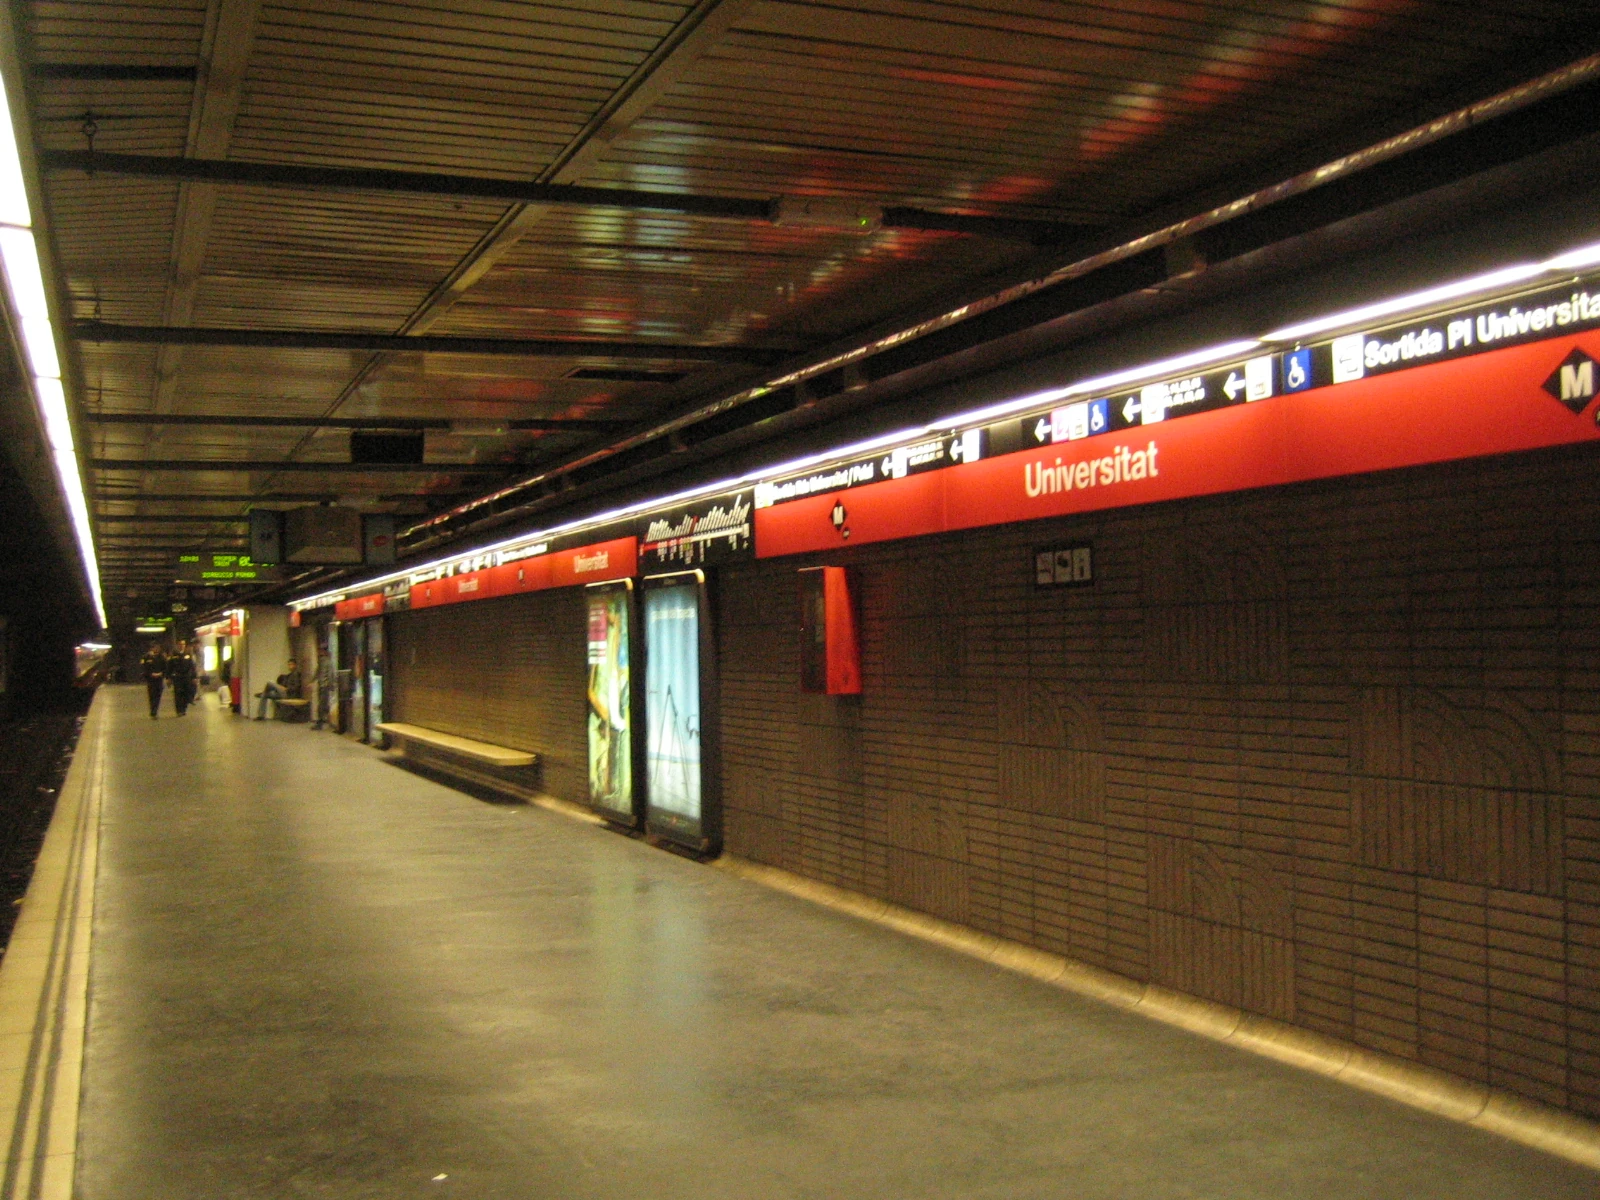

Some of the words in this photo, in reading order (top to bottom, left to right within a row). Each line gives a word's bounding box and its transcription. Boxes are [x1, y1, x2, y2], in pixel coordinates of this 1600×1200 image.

[1364, 328, 1443, 368] Sortida
[1560, 360, 1593, 400] M
[1025, 441, 1159, 498] Universitat
